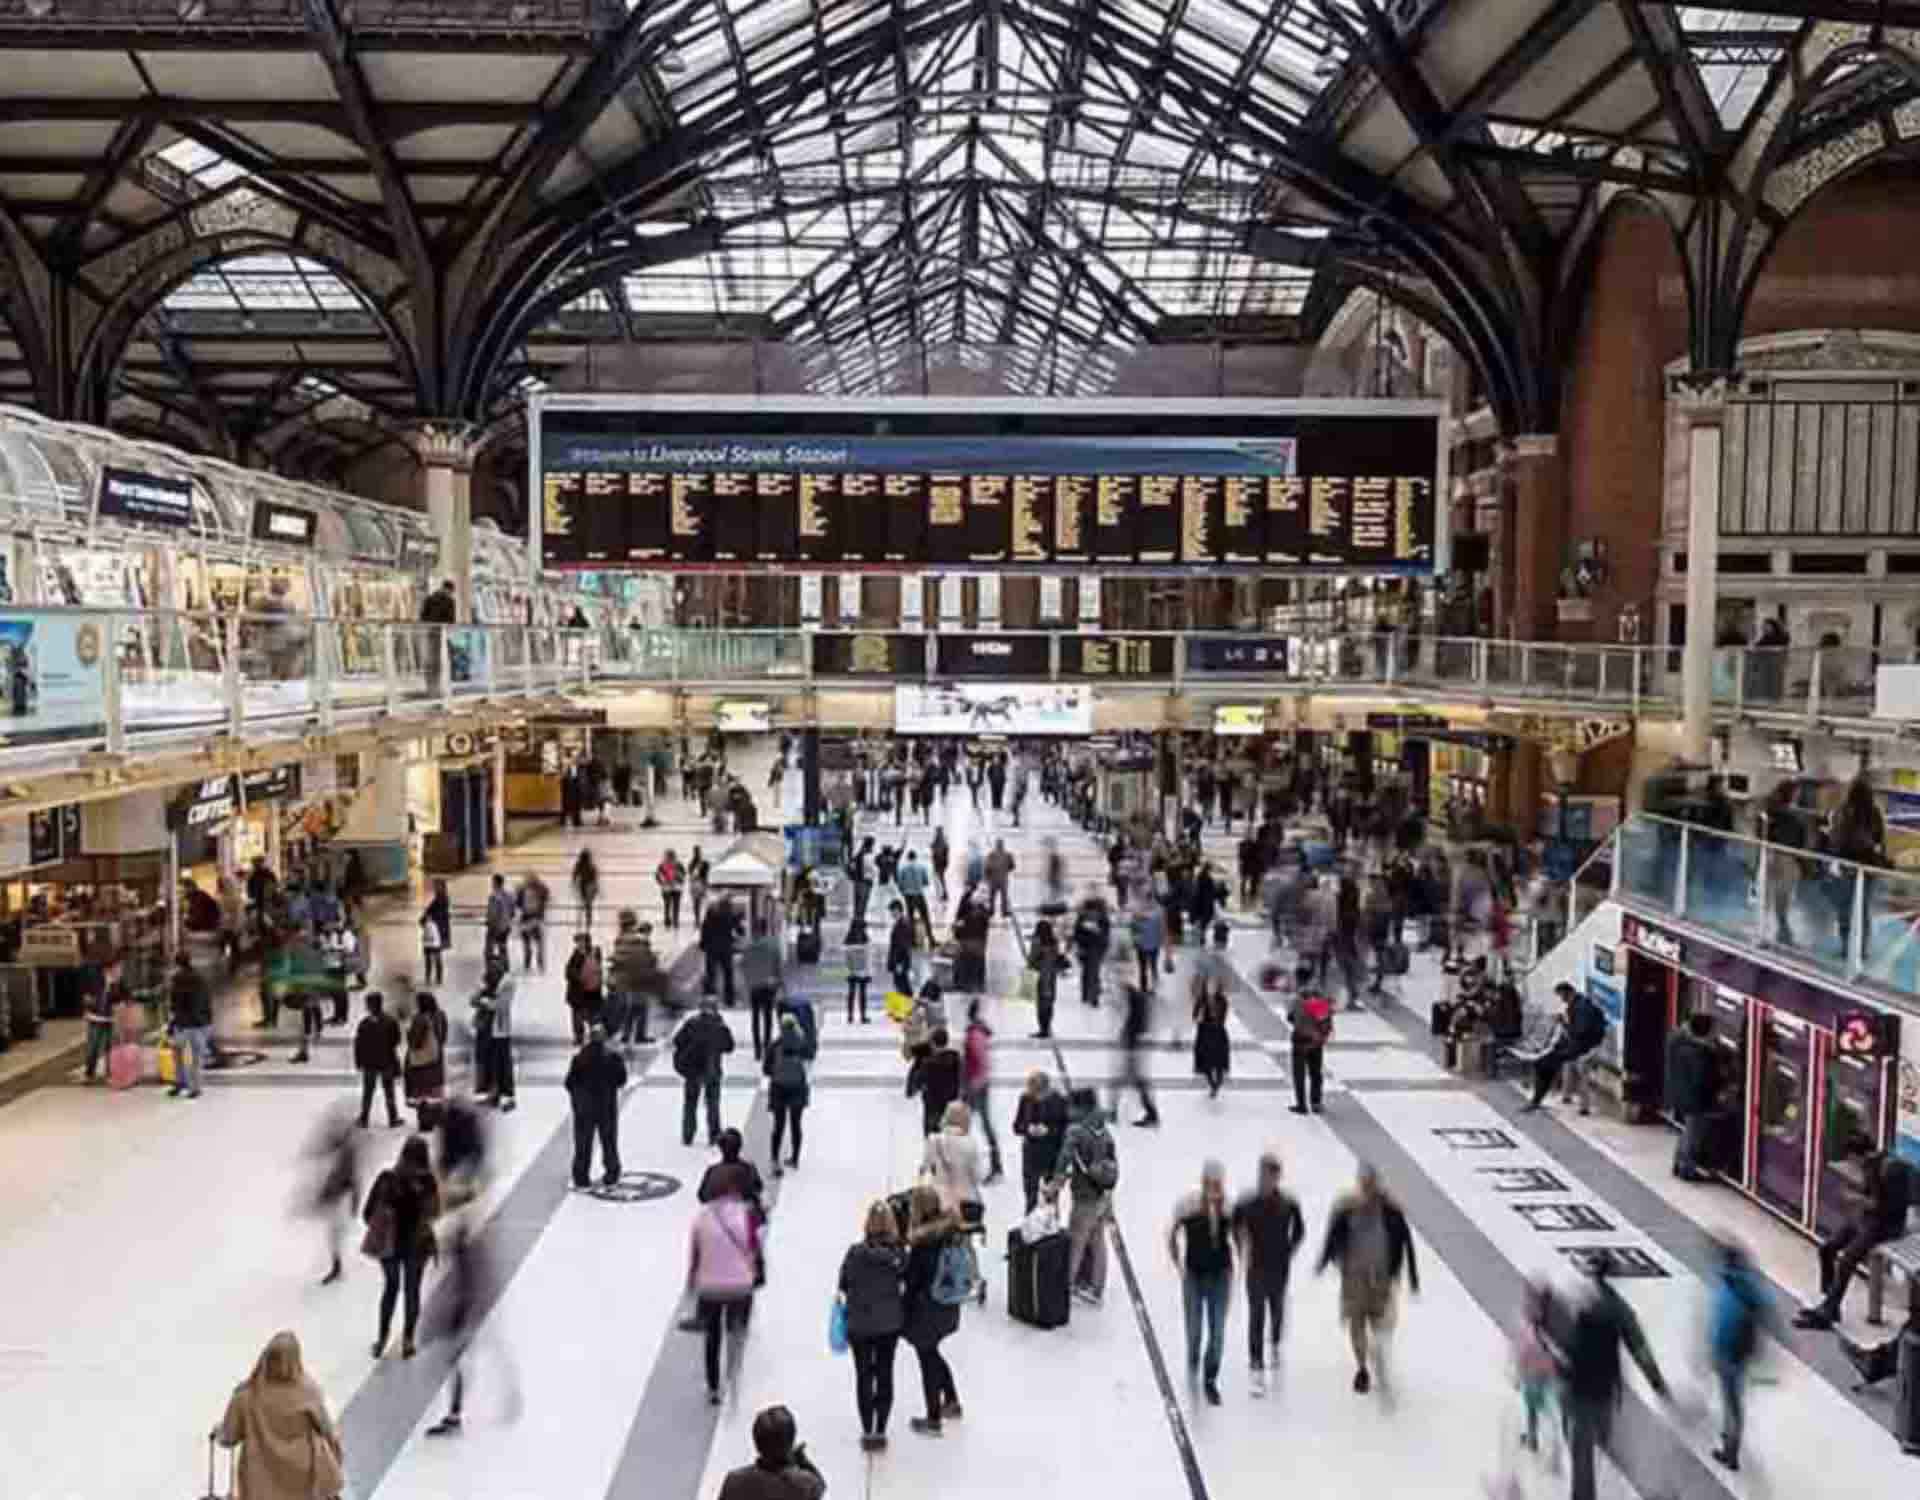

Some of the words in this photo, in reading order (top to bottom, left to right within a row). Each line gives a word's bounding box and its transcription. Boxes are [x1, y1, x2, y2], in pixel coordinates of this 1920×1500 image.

[649, 446, 727, 467] Liverpool
[729, 446, 781, 464] Street
[784, 446, 848, 464] Station
